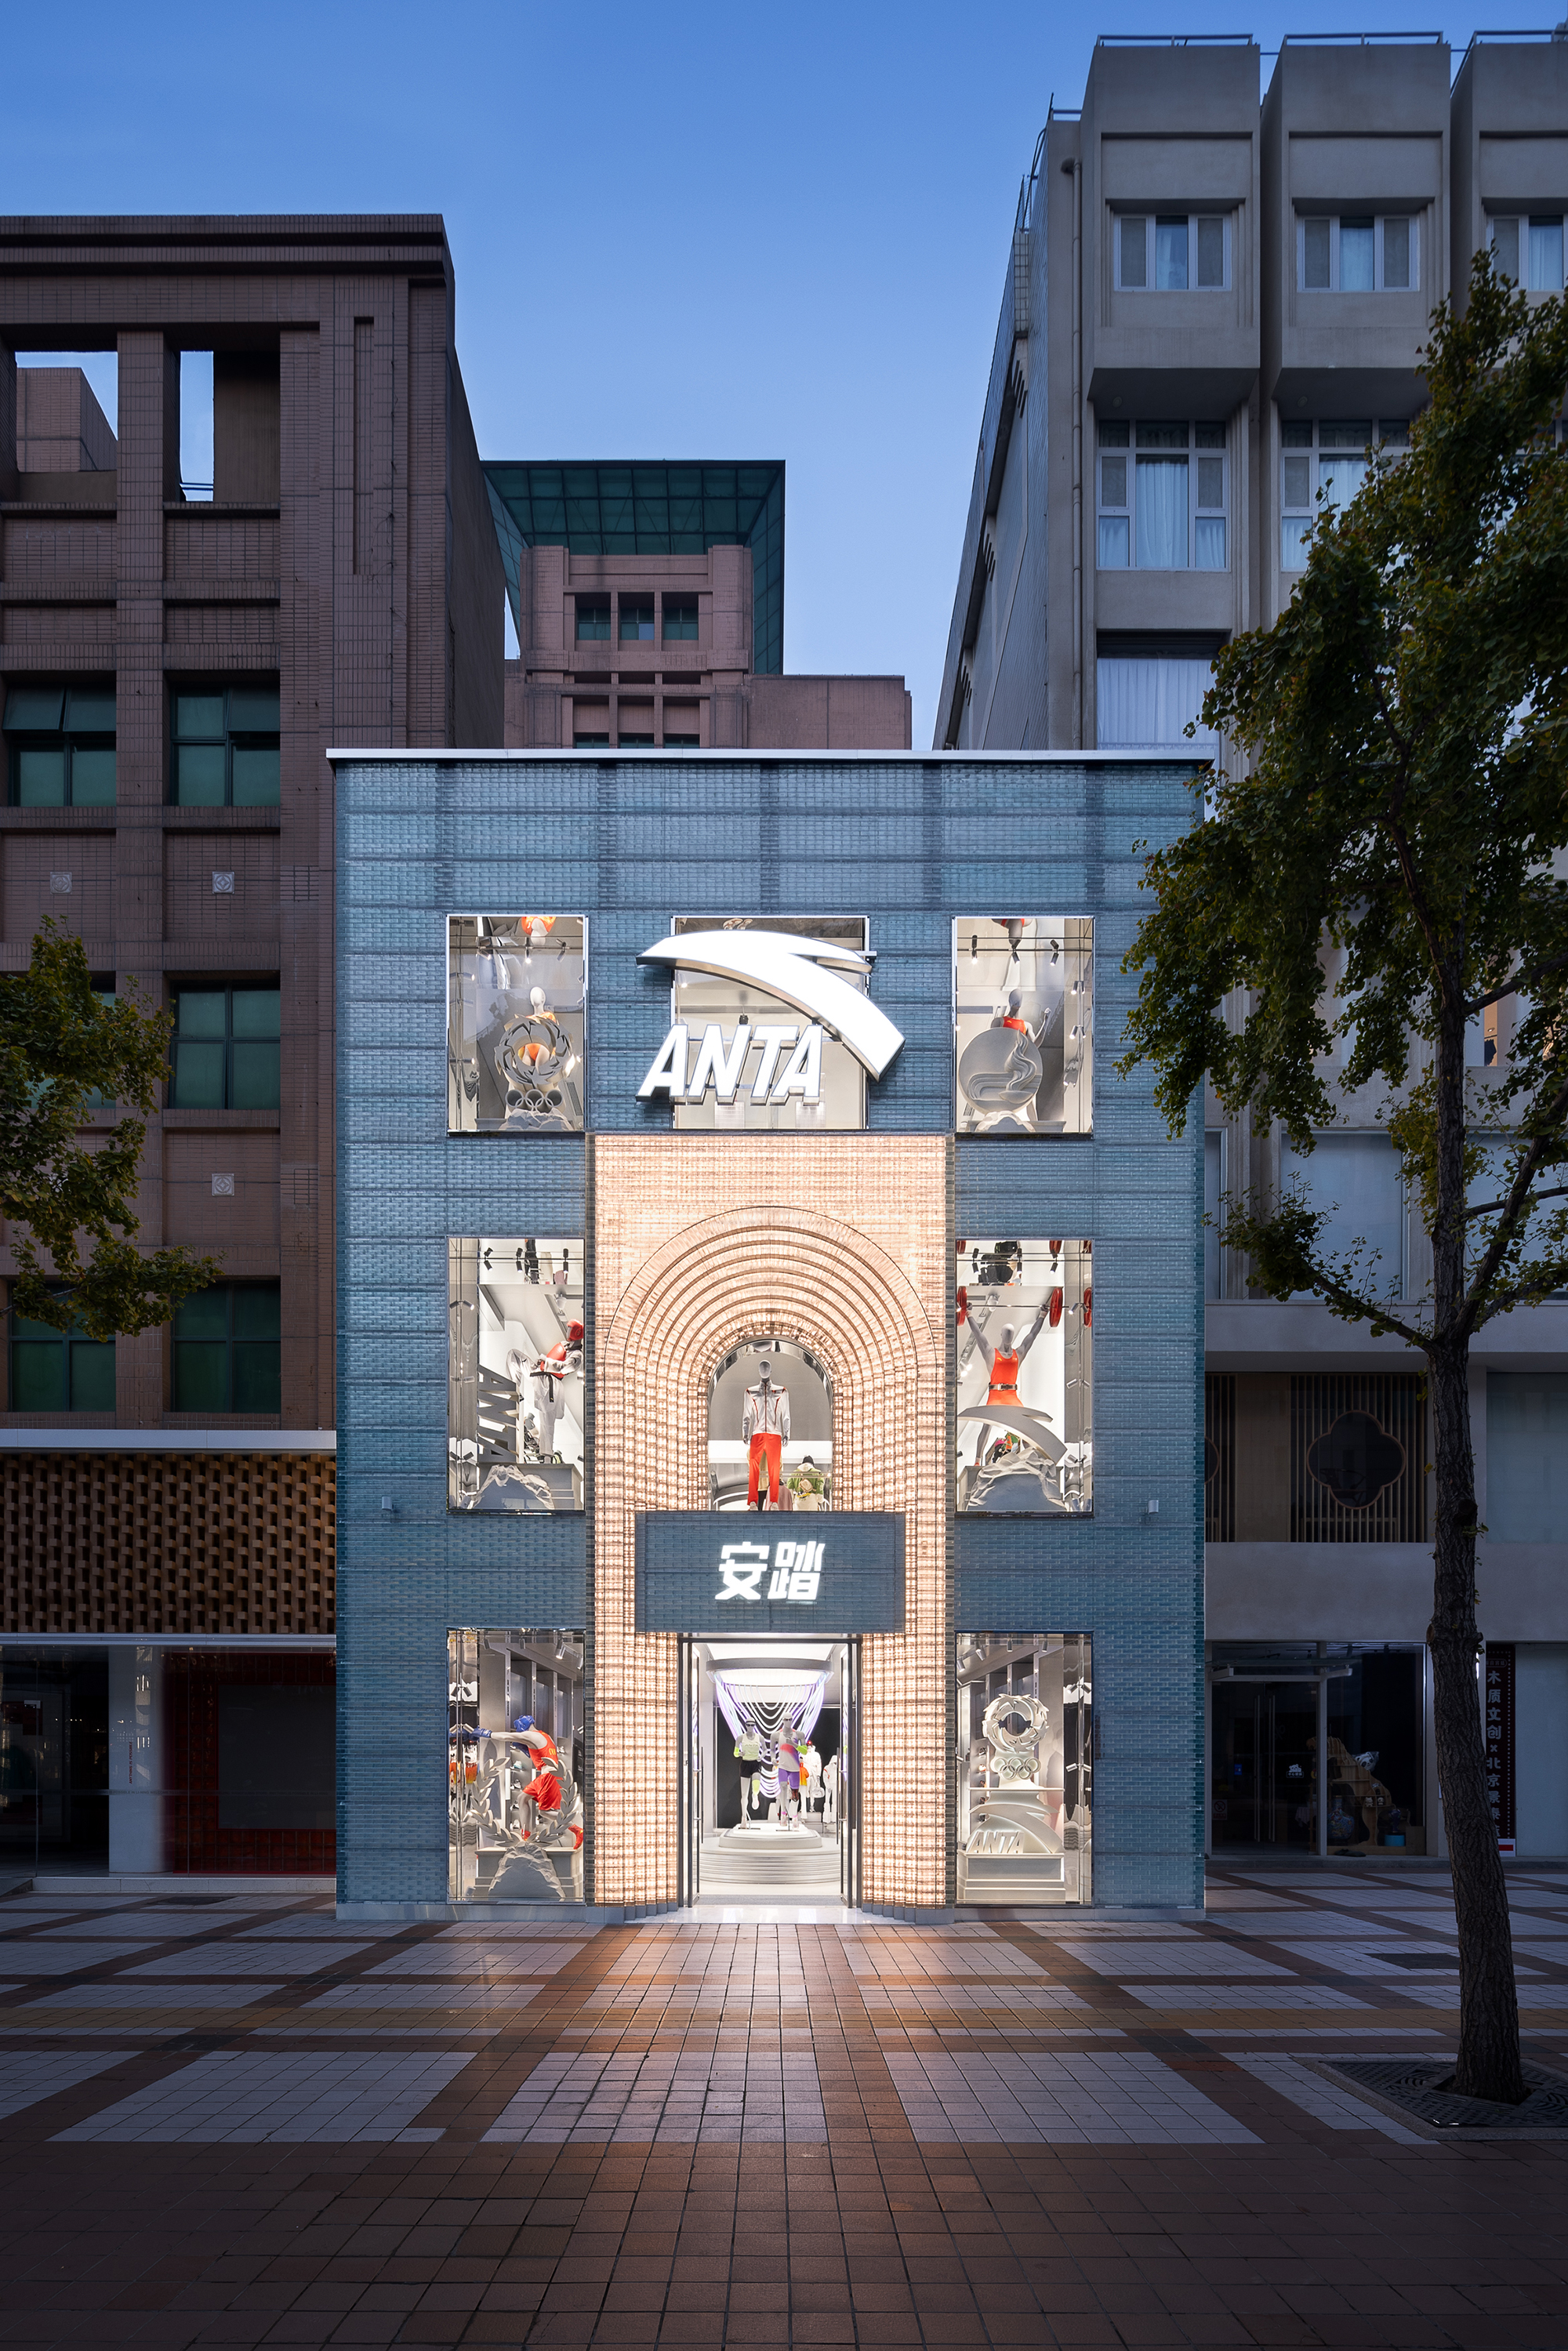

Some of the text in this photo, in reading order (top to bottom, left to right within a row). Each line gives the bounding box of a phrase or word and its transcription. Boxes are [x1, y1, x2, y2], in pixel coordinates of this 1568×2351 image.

[636, 1024, 823, 1100] ANTA
[477, 1363, 517, 1464] ANTA
[715, 1541, 826, 1600] 安踏
[967, 1830, 1024, 1853] ANTA
